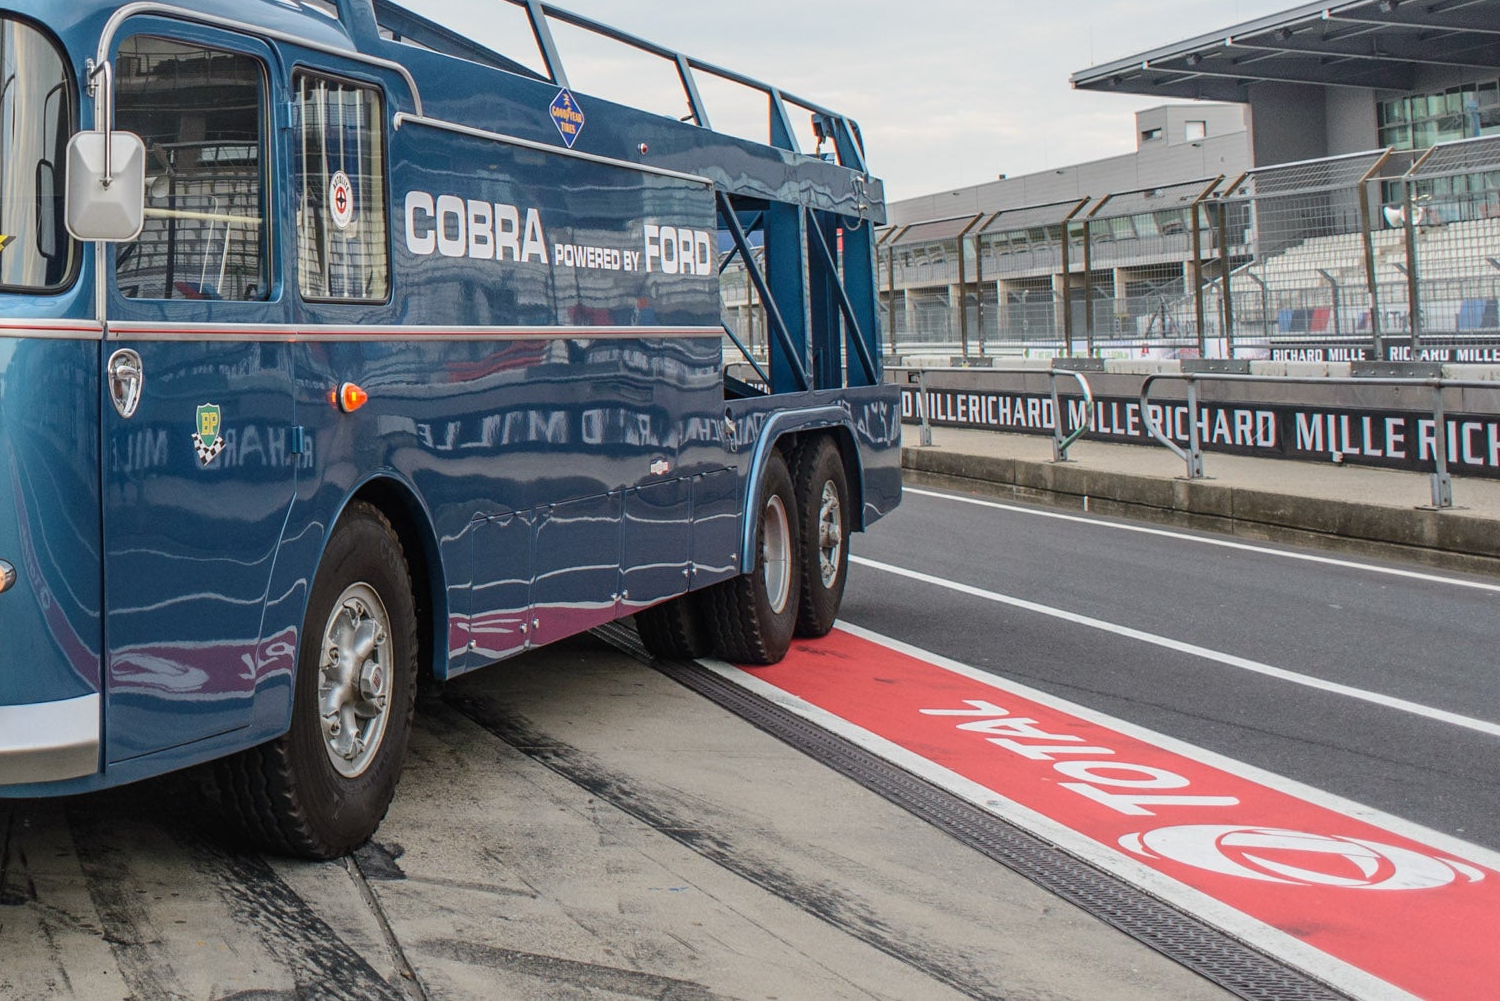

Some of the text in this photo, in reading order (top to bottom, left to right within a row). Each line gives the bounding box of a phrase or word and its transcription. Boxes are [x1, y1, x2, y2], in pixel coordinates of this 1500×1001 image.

[404, 190, 712, 276] COBRA POWERED BY FORD
[1273, 348, 1323, 362] RICHARD
[1327, 348, 1366, 362] MILLE
[1390, 346, 1450, 362] RICARD
[201, 412, 218, 436] BP
[1067, 399, 1142, 436] MILLE
[1147, 404, 1276, 448] RICHARD
[1295, 412, 1408, 459] MILLE
[919, 699, 1240, 816] TOTAL
